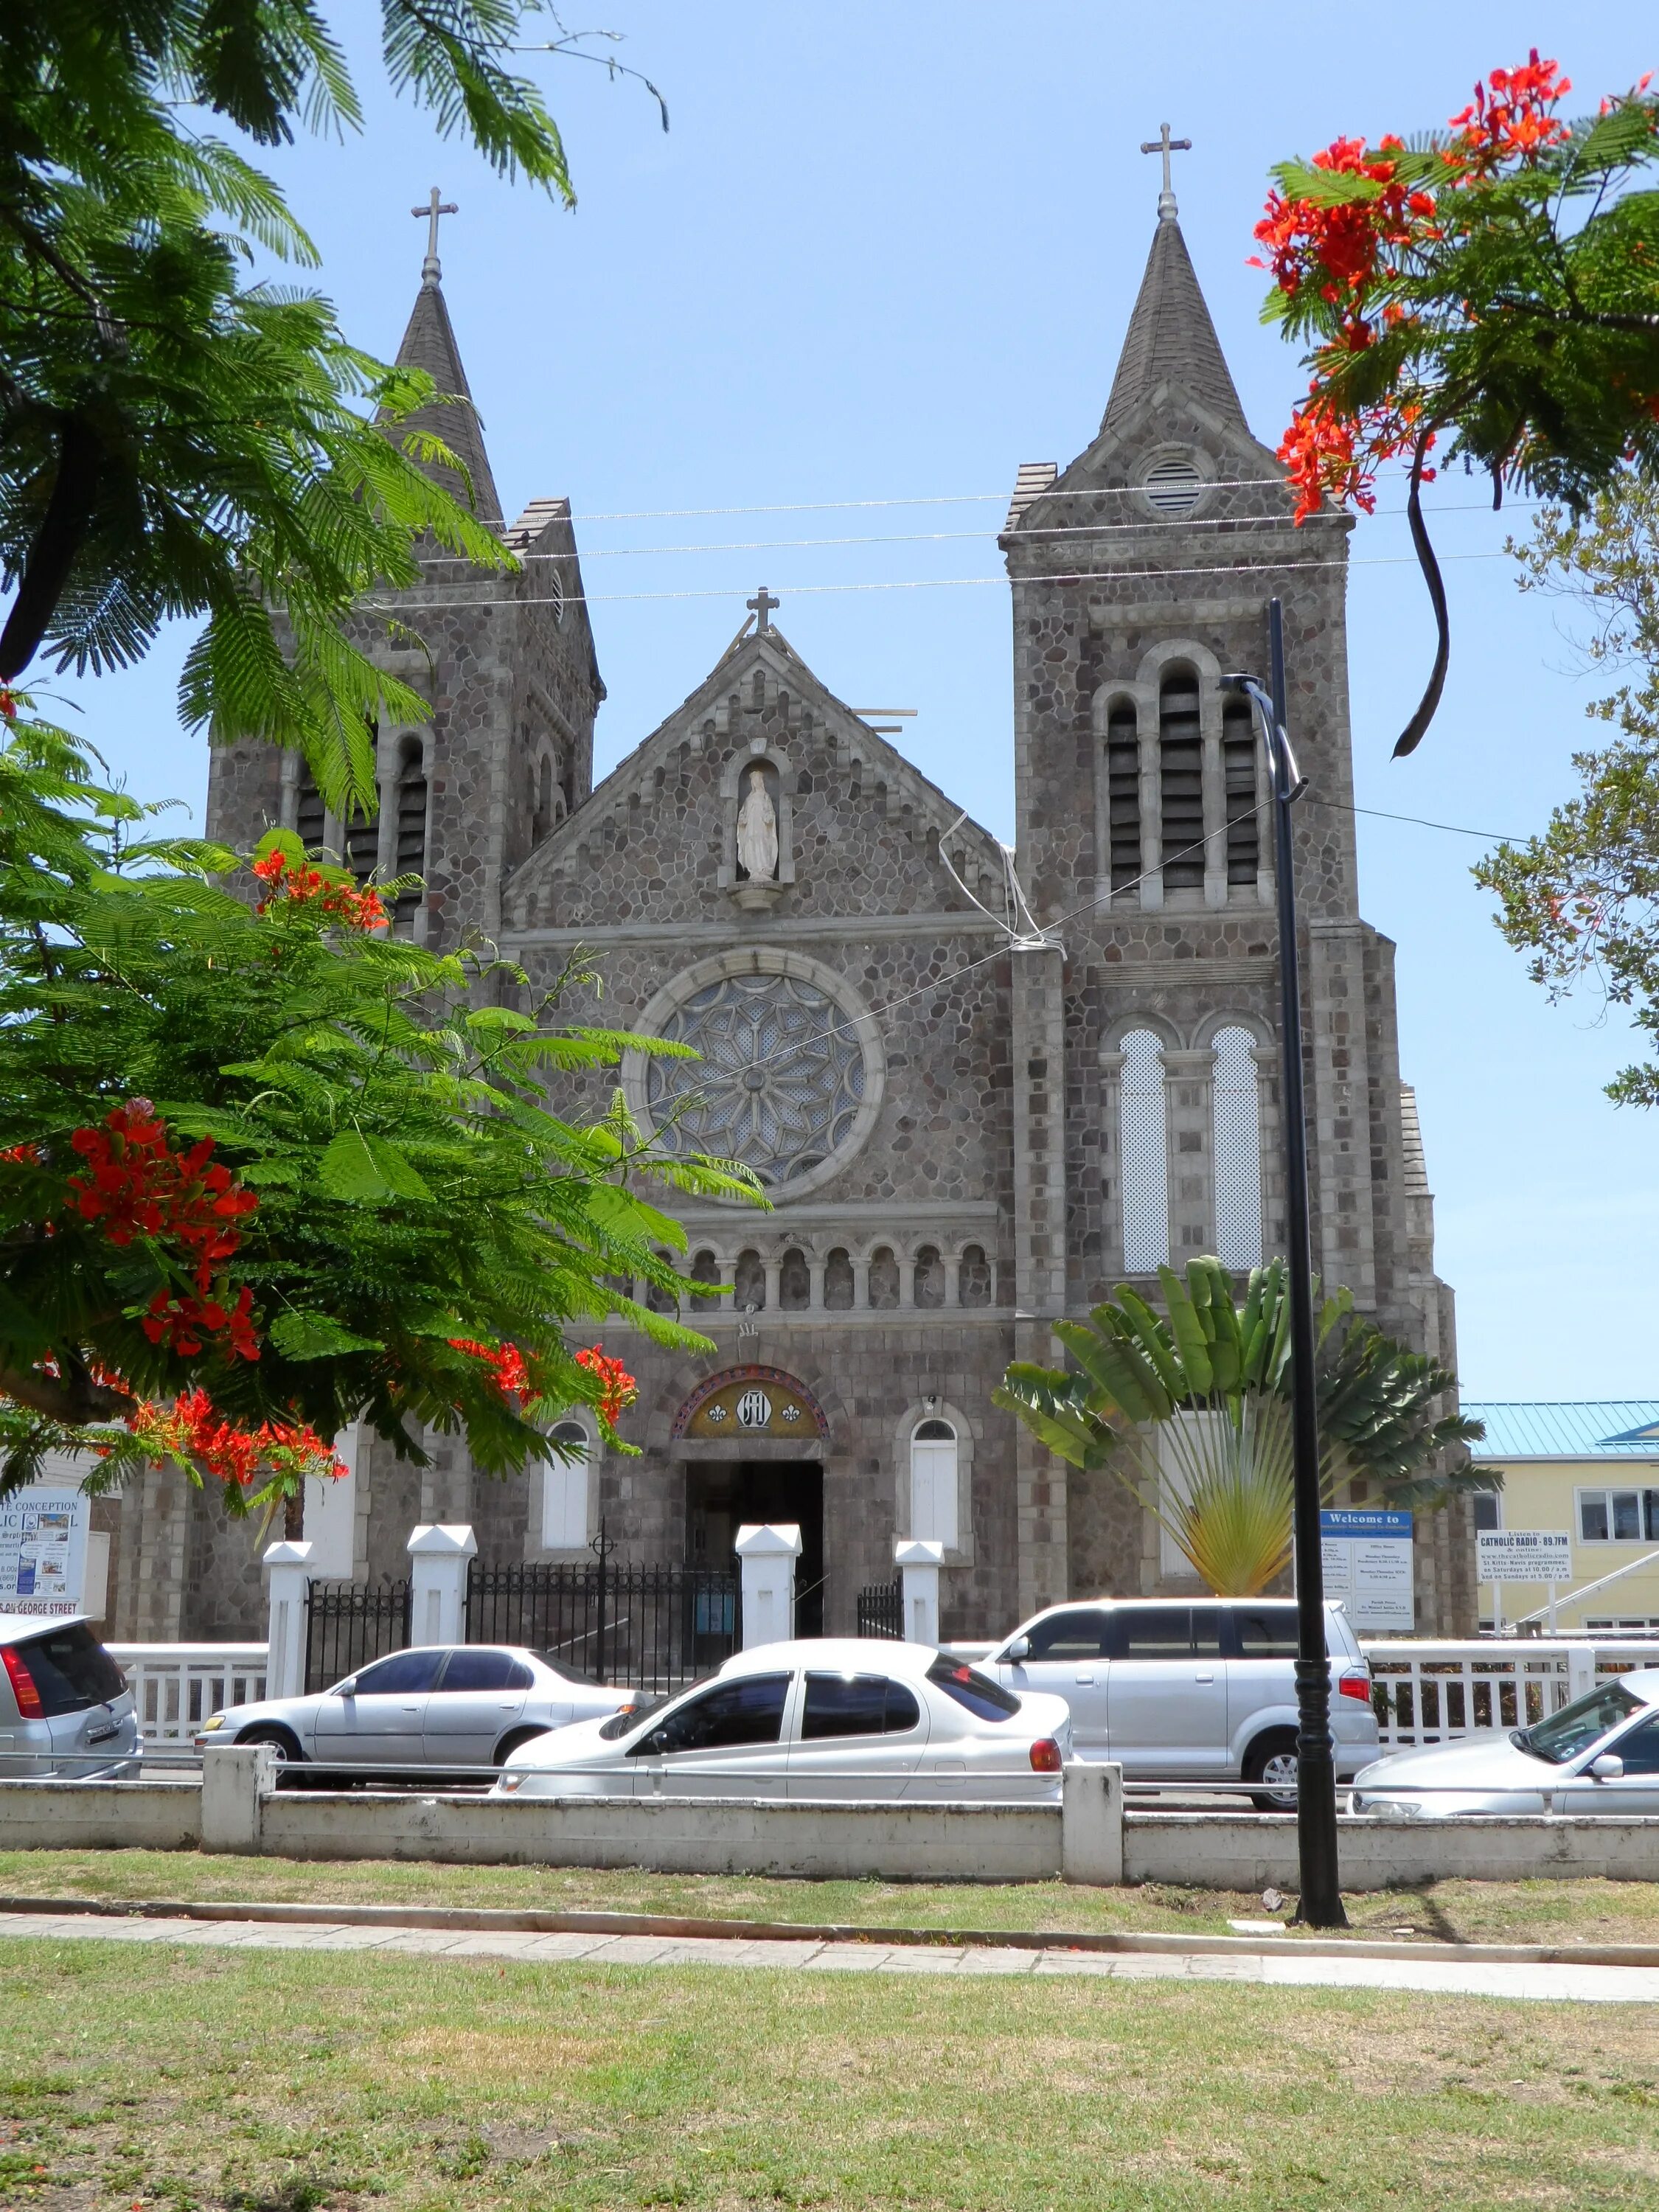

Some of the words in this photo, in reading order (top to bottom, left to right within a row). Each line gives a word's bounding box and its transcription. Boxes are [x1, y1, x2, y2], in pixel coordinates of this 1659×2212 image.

[15, 1502, 77, 1511] CONCEPTION
[1329, 1514, 1383, 1523] Welcome
[1386, 1514, 1399, 1523] to
[1481, 1537, 1514, 1546] CATHOLIC
[1516, 1537, 1537, 1546] RADIO
[1543, 1537, 1568, 1546] 89.7FM
[18, 1603, 48, 1615] GEORGE
[49, 1603, 77, 1615] STREET
